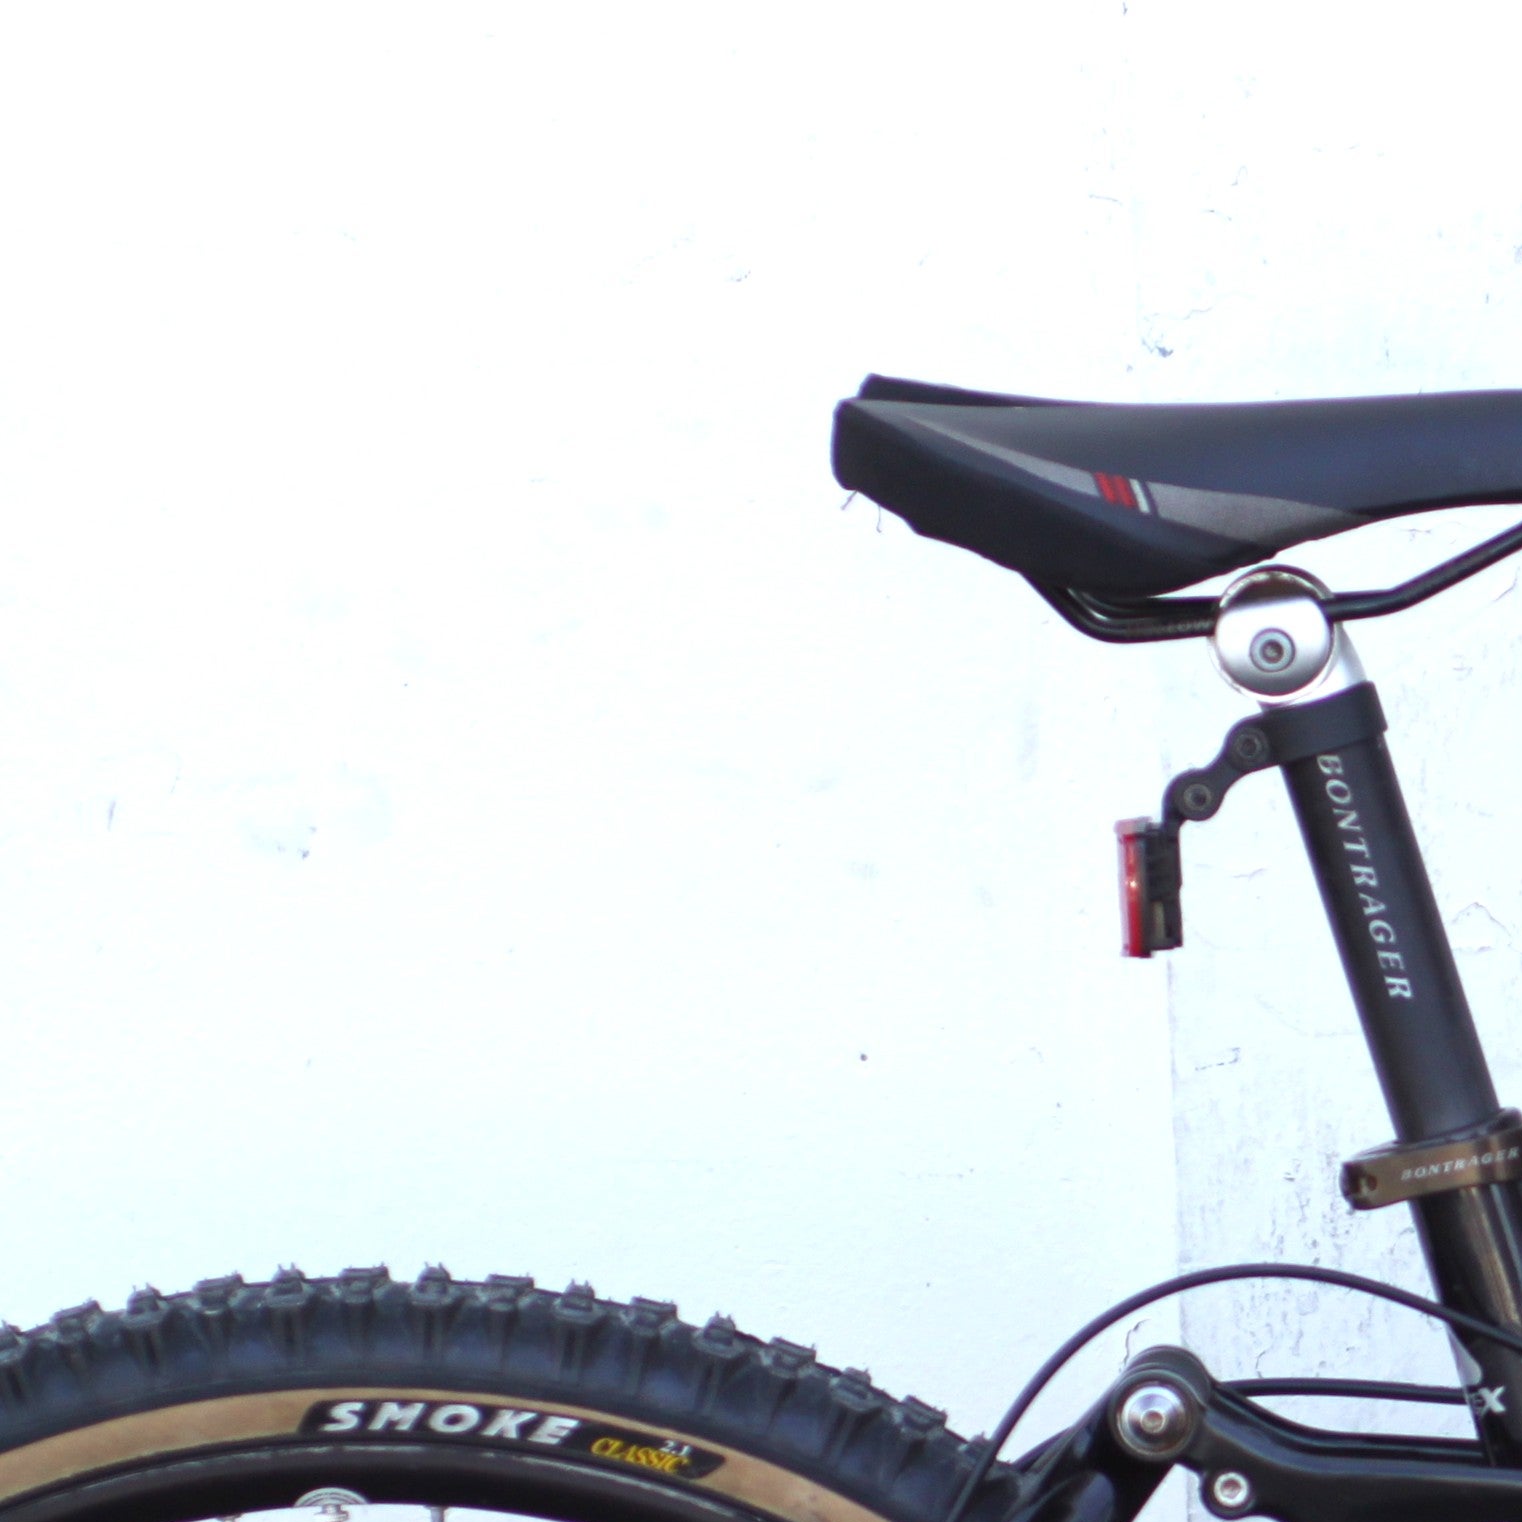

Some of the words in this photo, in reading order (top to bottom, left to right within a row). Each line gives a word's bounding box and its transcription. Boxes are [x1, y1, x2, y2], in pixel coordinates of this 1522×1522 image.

[1316, 754, 1413, 999] BONTRAGER
[1400, 1146, 1521, 1182] BONTRAGER
[318, 1401, 580, 1446] SMOKE
[590, 1436, 693, 1475] CLASSIC
